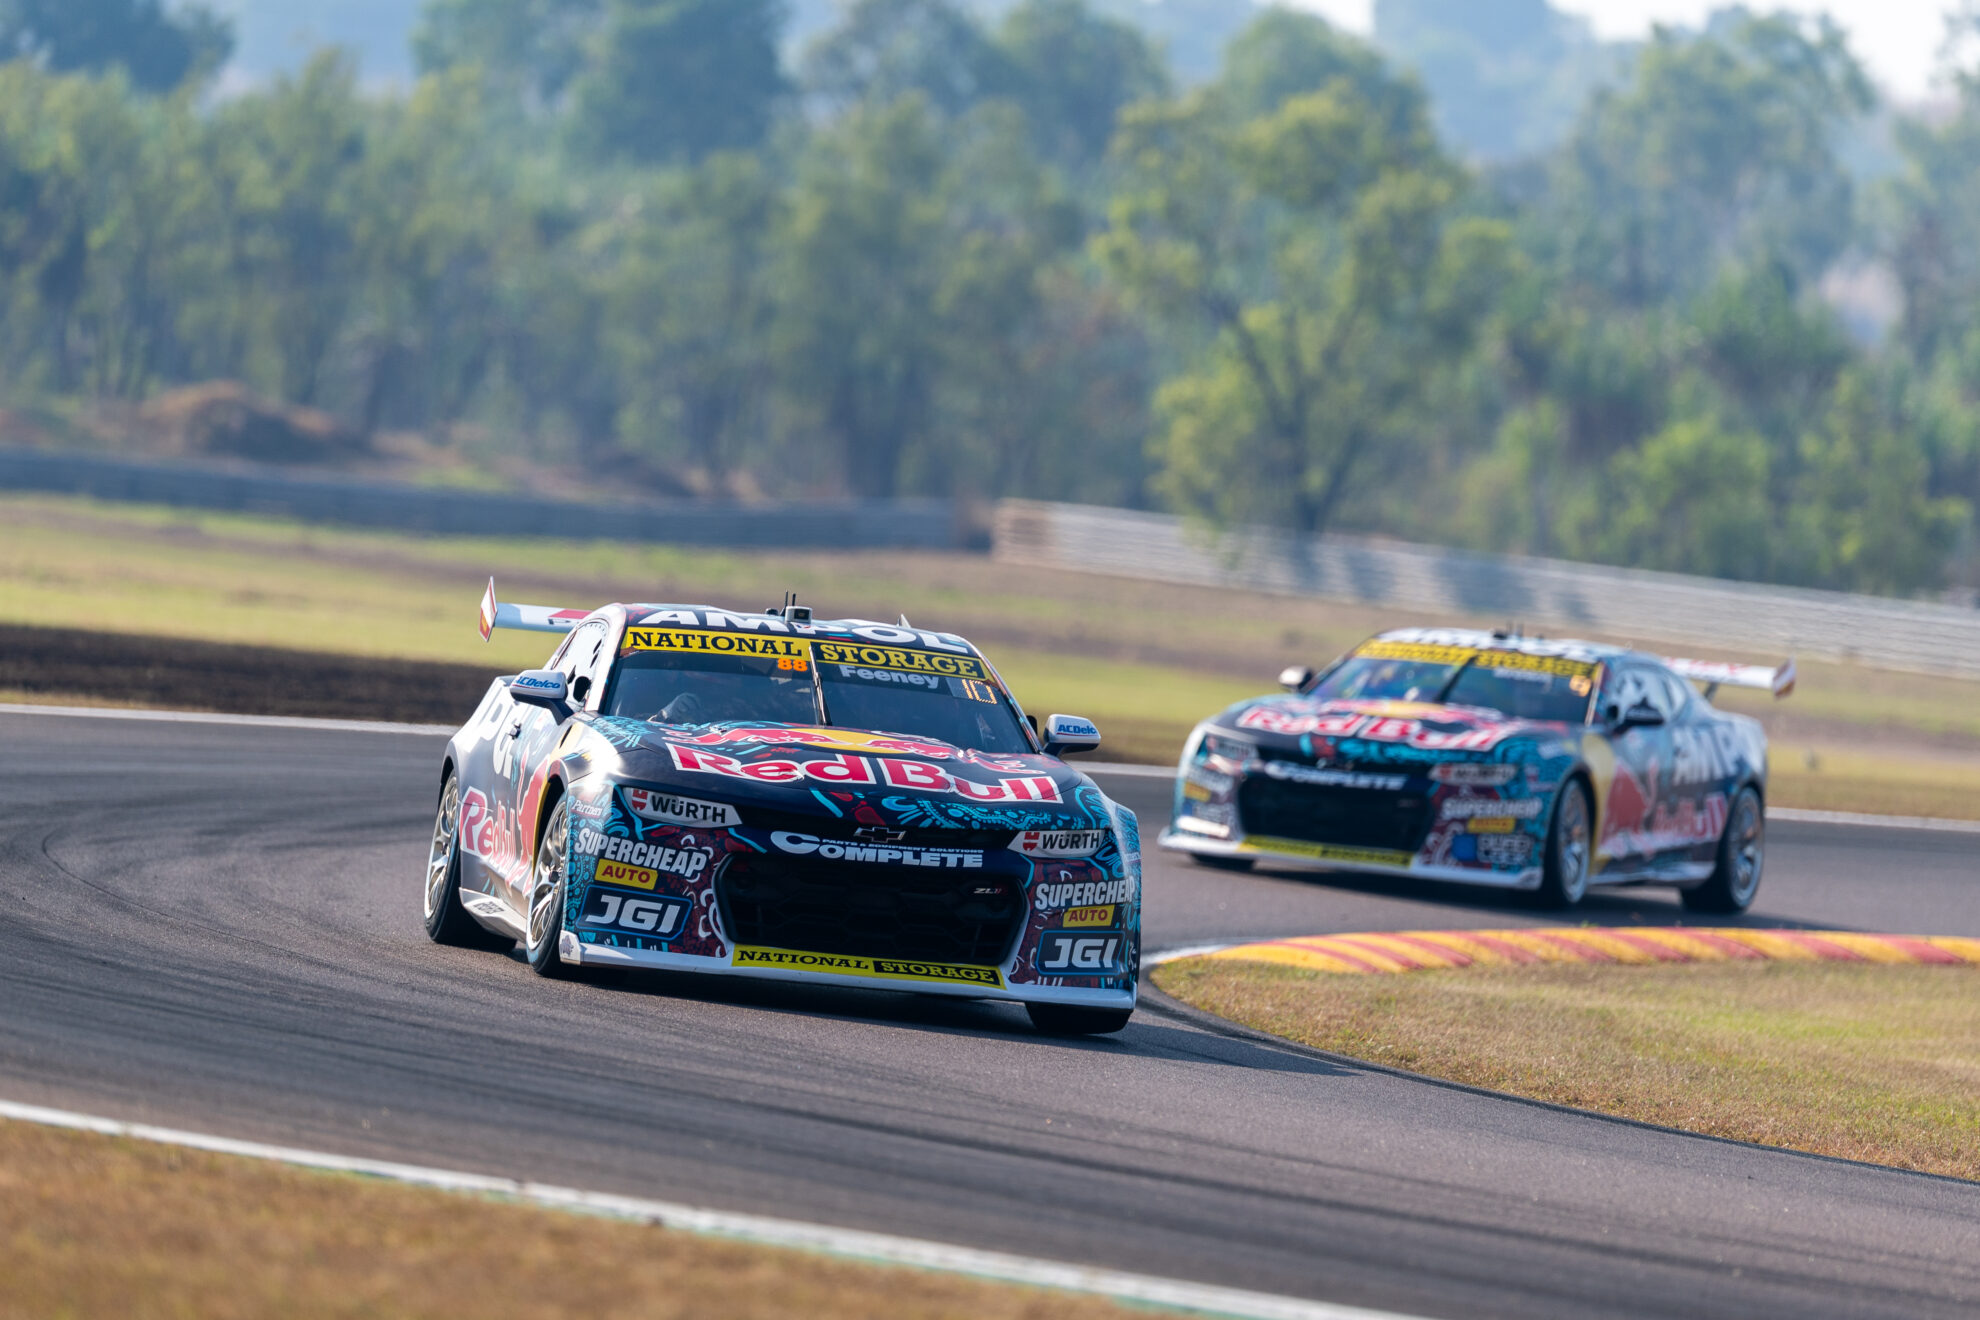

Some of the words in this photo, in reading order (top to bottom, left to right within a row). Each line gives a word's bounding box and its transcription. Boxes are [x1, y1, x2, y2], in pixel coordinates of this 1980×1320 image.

[630, 632, 802, 656] NATIONAL
[820, 644, 978, 677] STORAGE
[777, 658, 808, 671] 88
[839, 664, 939, 689] Feeney
[962, 678, 998, 704] 10
[1057, 724, 1097, 735] ACDelc
[1236, 706, 1369, 737] Red
[1357, 715, 1512, 751] Bull
[664, 742, 877, 784] Red
[876, 757, 1064, 804] Bull
[1264, 760, 1408, 791] COMPLETE
[574, 827, 708, 878] SUPERCHEAP
[770, 830, 984, 868] COMPLETE
[601, 865, 651, 884] AUTO
[1034, 875, 1137, 911] SUPERCHEAP
[585, 895, 681, 934] JGI
[1068, 909, 1109, 922] AUTO
[738, 950, 869, 970] NATIONAL
[882, 961, 995, 982] STORAGE
[1045, 938, 1119, 968] JGI
